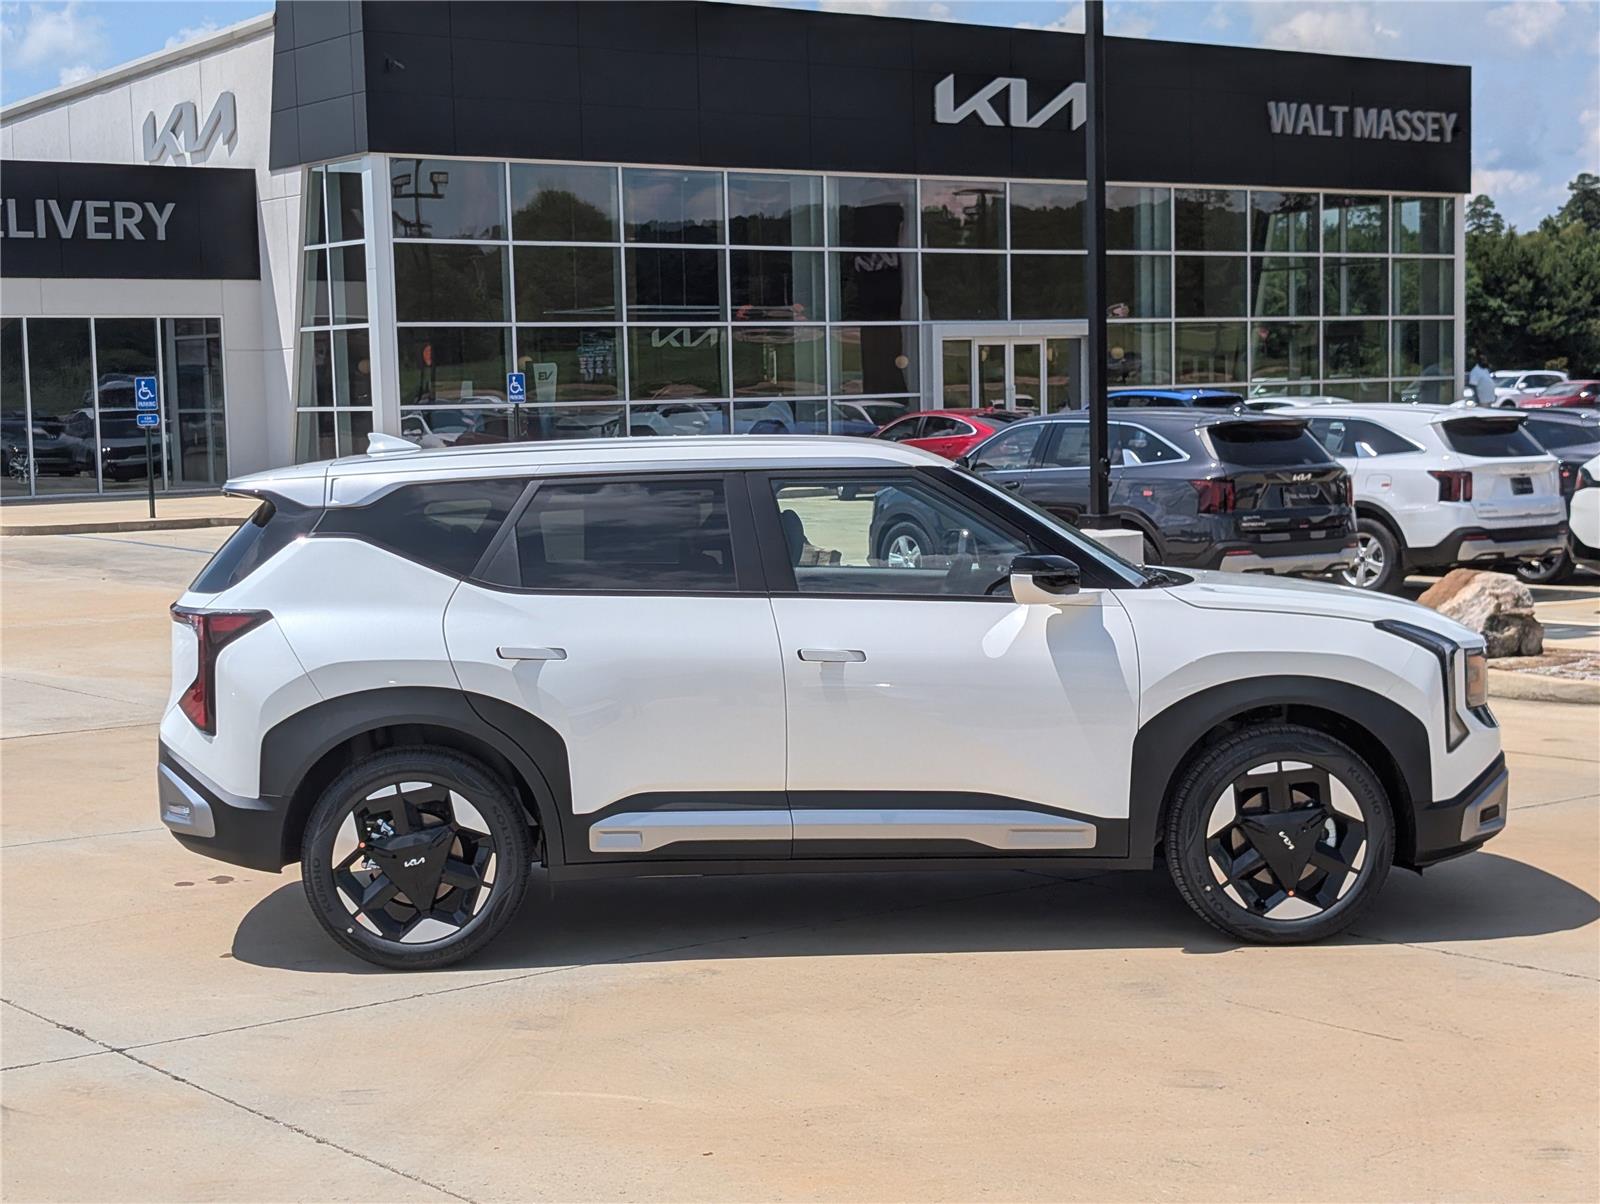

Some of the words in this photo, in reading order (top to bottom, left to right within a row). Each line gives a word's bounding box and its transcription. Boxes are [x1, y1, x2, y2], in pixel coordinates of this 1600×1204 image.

[935, 73, 1087, 131] KIA
[1267, 101, 1349, 138] WALT
[1353, 107, 1458, 143] MASSEY
[143, 91, 237, 163] KIA
[0, 198, 176, 241] LIVERY
[651, 328, 718, 348] KIA
[1292, 473, 1312, 482] KIA
